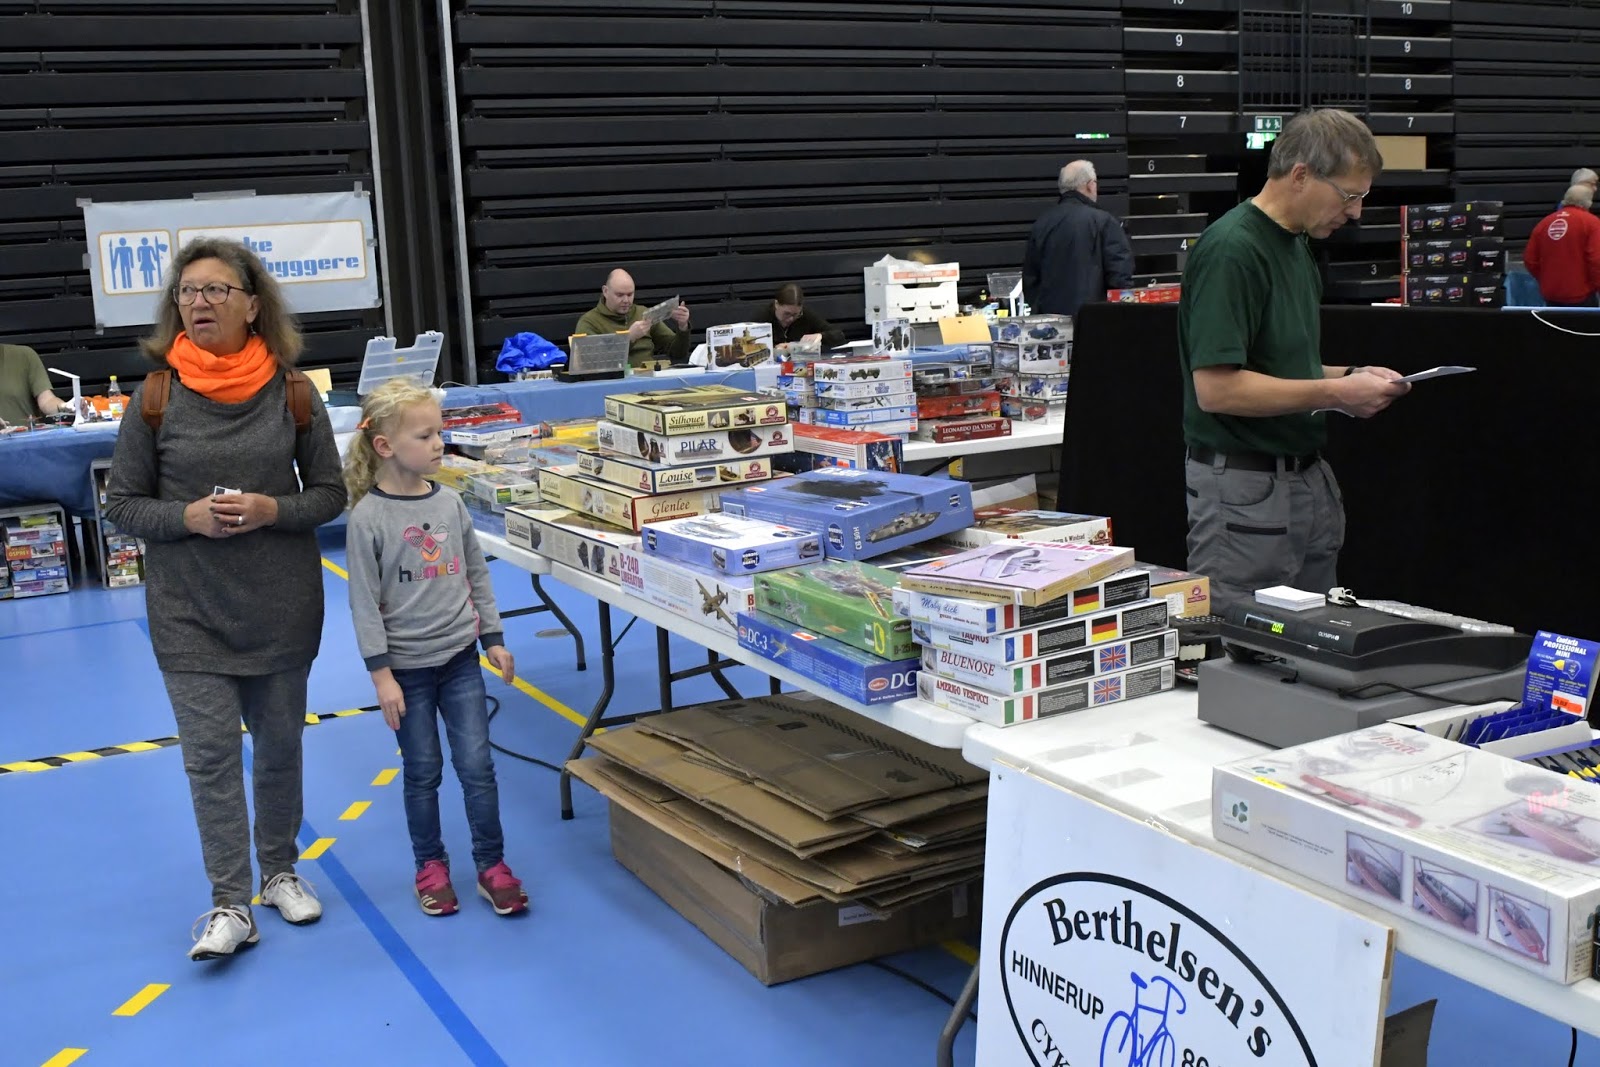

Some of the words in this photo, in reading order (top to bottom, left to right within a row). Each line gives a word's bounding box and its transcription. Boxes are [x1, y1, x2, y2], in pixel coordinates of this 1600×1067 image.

[1401, 3, 1413, 15] 10
[1175, 34, 1183, 46] 9
[1404, 41, 1411, 53] 9
[1176, 75, 1184, 87] 8
[1405, 78, 1412, 90] 8
[1180, 116, 1187, 128] 7
[1407, 117, 1414, 128] 7
[1148, 160, 1155, 171] 6
[243, 236, 273, 253] ke
[1180, 239, 1188, 251] 4
[263, 256, 359, 277] byggere
[1370, 264, 1377, 275] 3
[670, 415, 705, 425] Silhouet
[942, 425, 972, 434] LEONARDO
[981, 422, 997, 430] VINCI
[681, 439, 717, 454] PILAR
[659, 469, 694, 483] Louise
[651, 498, 691, 515] Glenlee
[619, 553, 639, 575] B-24D
[621, 570, 645, 590] LIBERATOR
[921, 597, 941, 612] Moby
[747, 628, 768, 650] DC-3
[1543, 640, 1587, 656] PROFESSIONAL
[1555, 650, 1571, 658] MINI
[940, 651, 996, 676] BLUENOSE
[890, 670, 917, 690] DC
[936, 680, 961, 695] AMERIGO
[962, 687, 989, 705] VESPUCCI
[1012, 949, 1104, 1020] HINNERUP
[1043, 898, 1272, 1058] Berthelsen's
